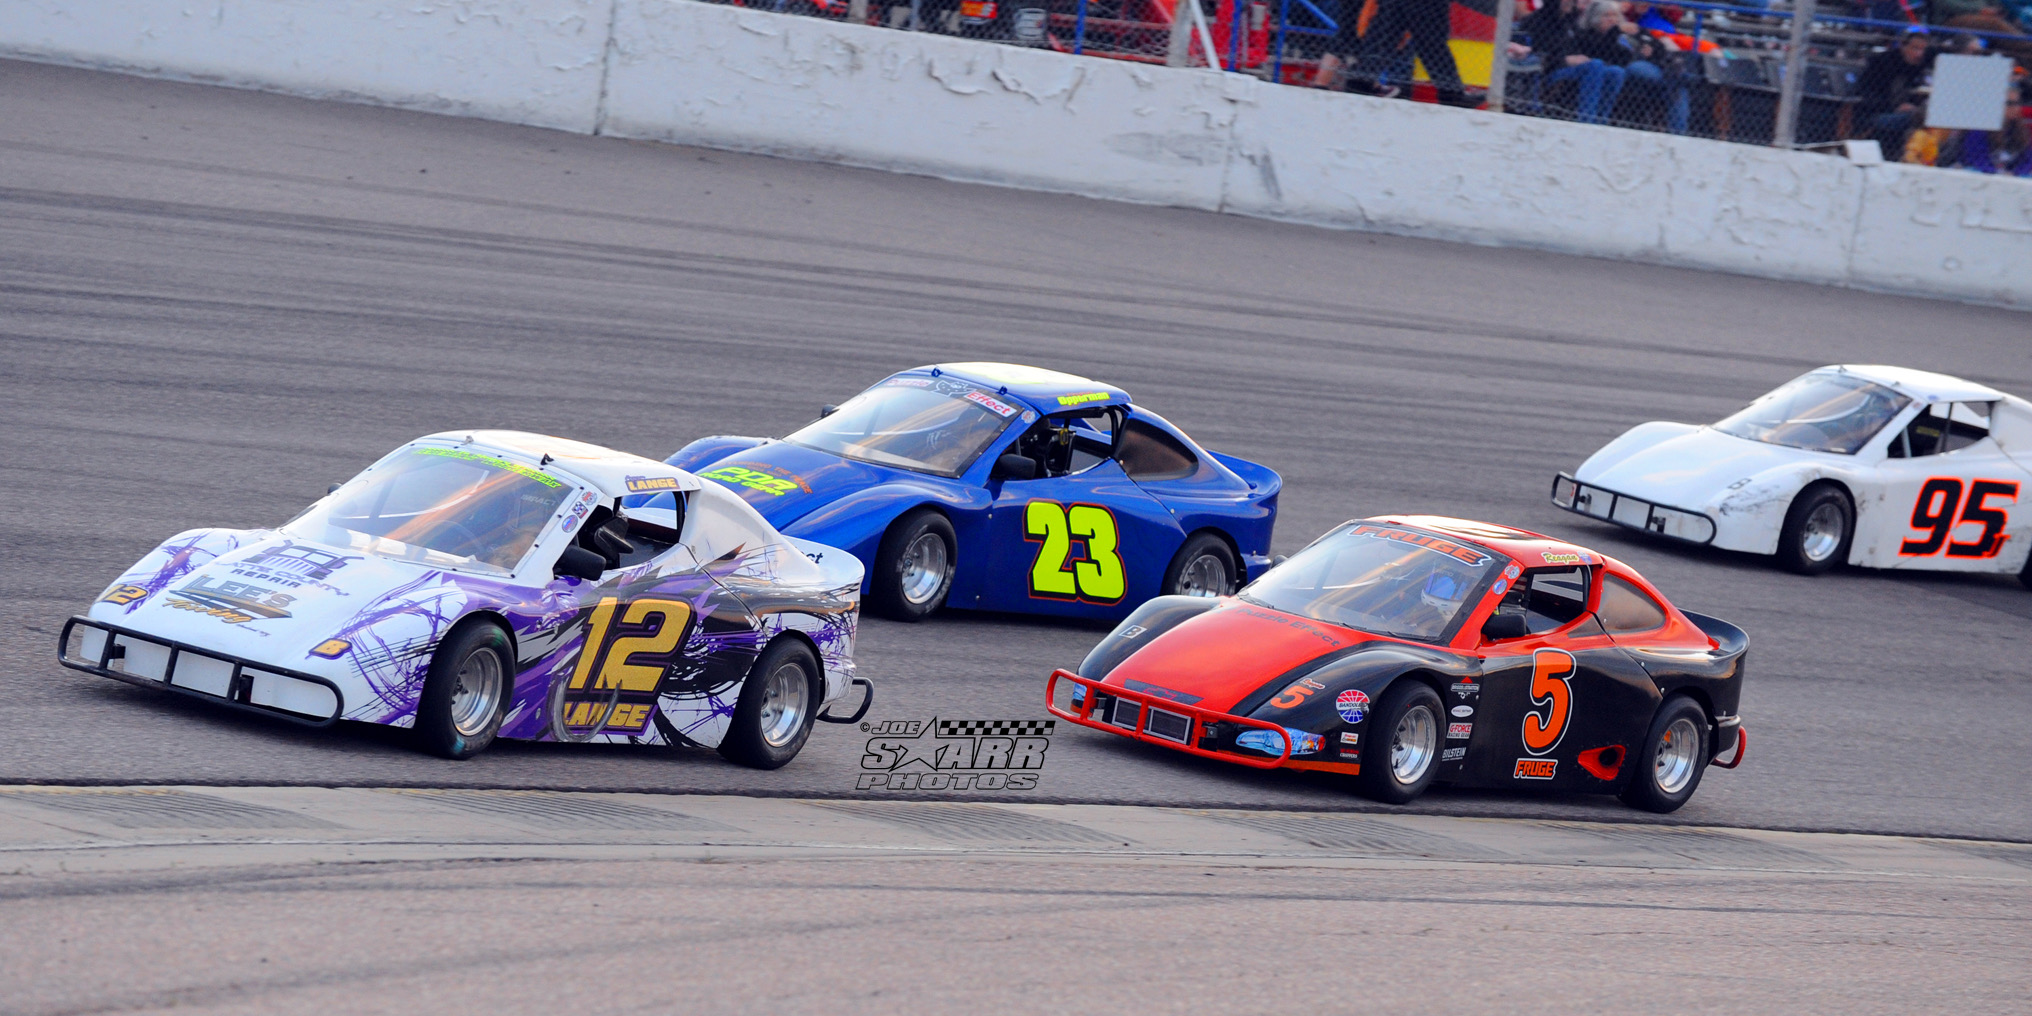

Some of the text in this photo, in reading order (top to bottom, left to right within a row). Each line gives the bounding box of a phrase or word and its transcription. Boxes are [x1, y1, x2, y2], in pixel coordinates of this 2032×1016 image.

[966, 390, 1011, 416] Effect
[1057, 391, 1110, 405] Opperman
[627, 478, 678, 491] LANGE
[711, 466, 798, 490] PDA
[1898, 475, 2021, 559] 95
[1024, 500, 1126, 603] 23
[1352, 526, 1485, 564] FRUGE
[1544, 552, 1579, 563] Reagan
[230, 568, 302, 588] REPAIR
[95, 583, 147, 606] 12
[180, 574, 298, 608] LEE'S
[162, 597, 252, 624] Towing
[1120, 625, 1143, 638] B
[1237, 607, 1340, 647] Puzzle Effect
[568, 596, 691, 692] 12
[1270, 685, 1314, 709] 5
[1523, 648, 1575, 753] 5
[1442, 747, 1466, 758] BILSTEIN
[1515, 760, 1556, 777] FRUGE
